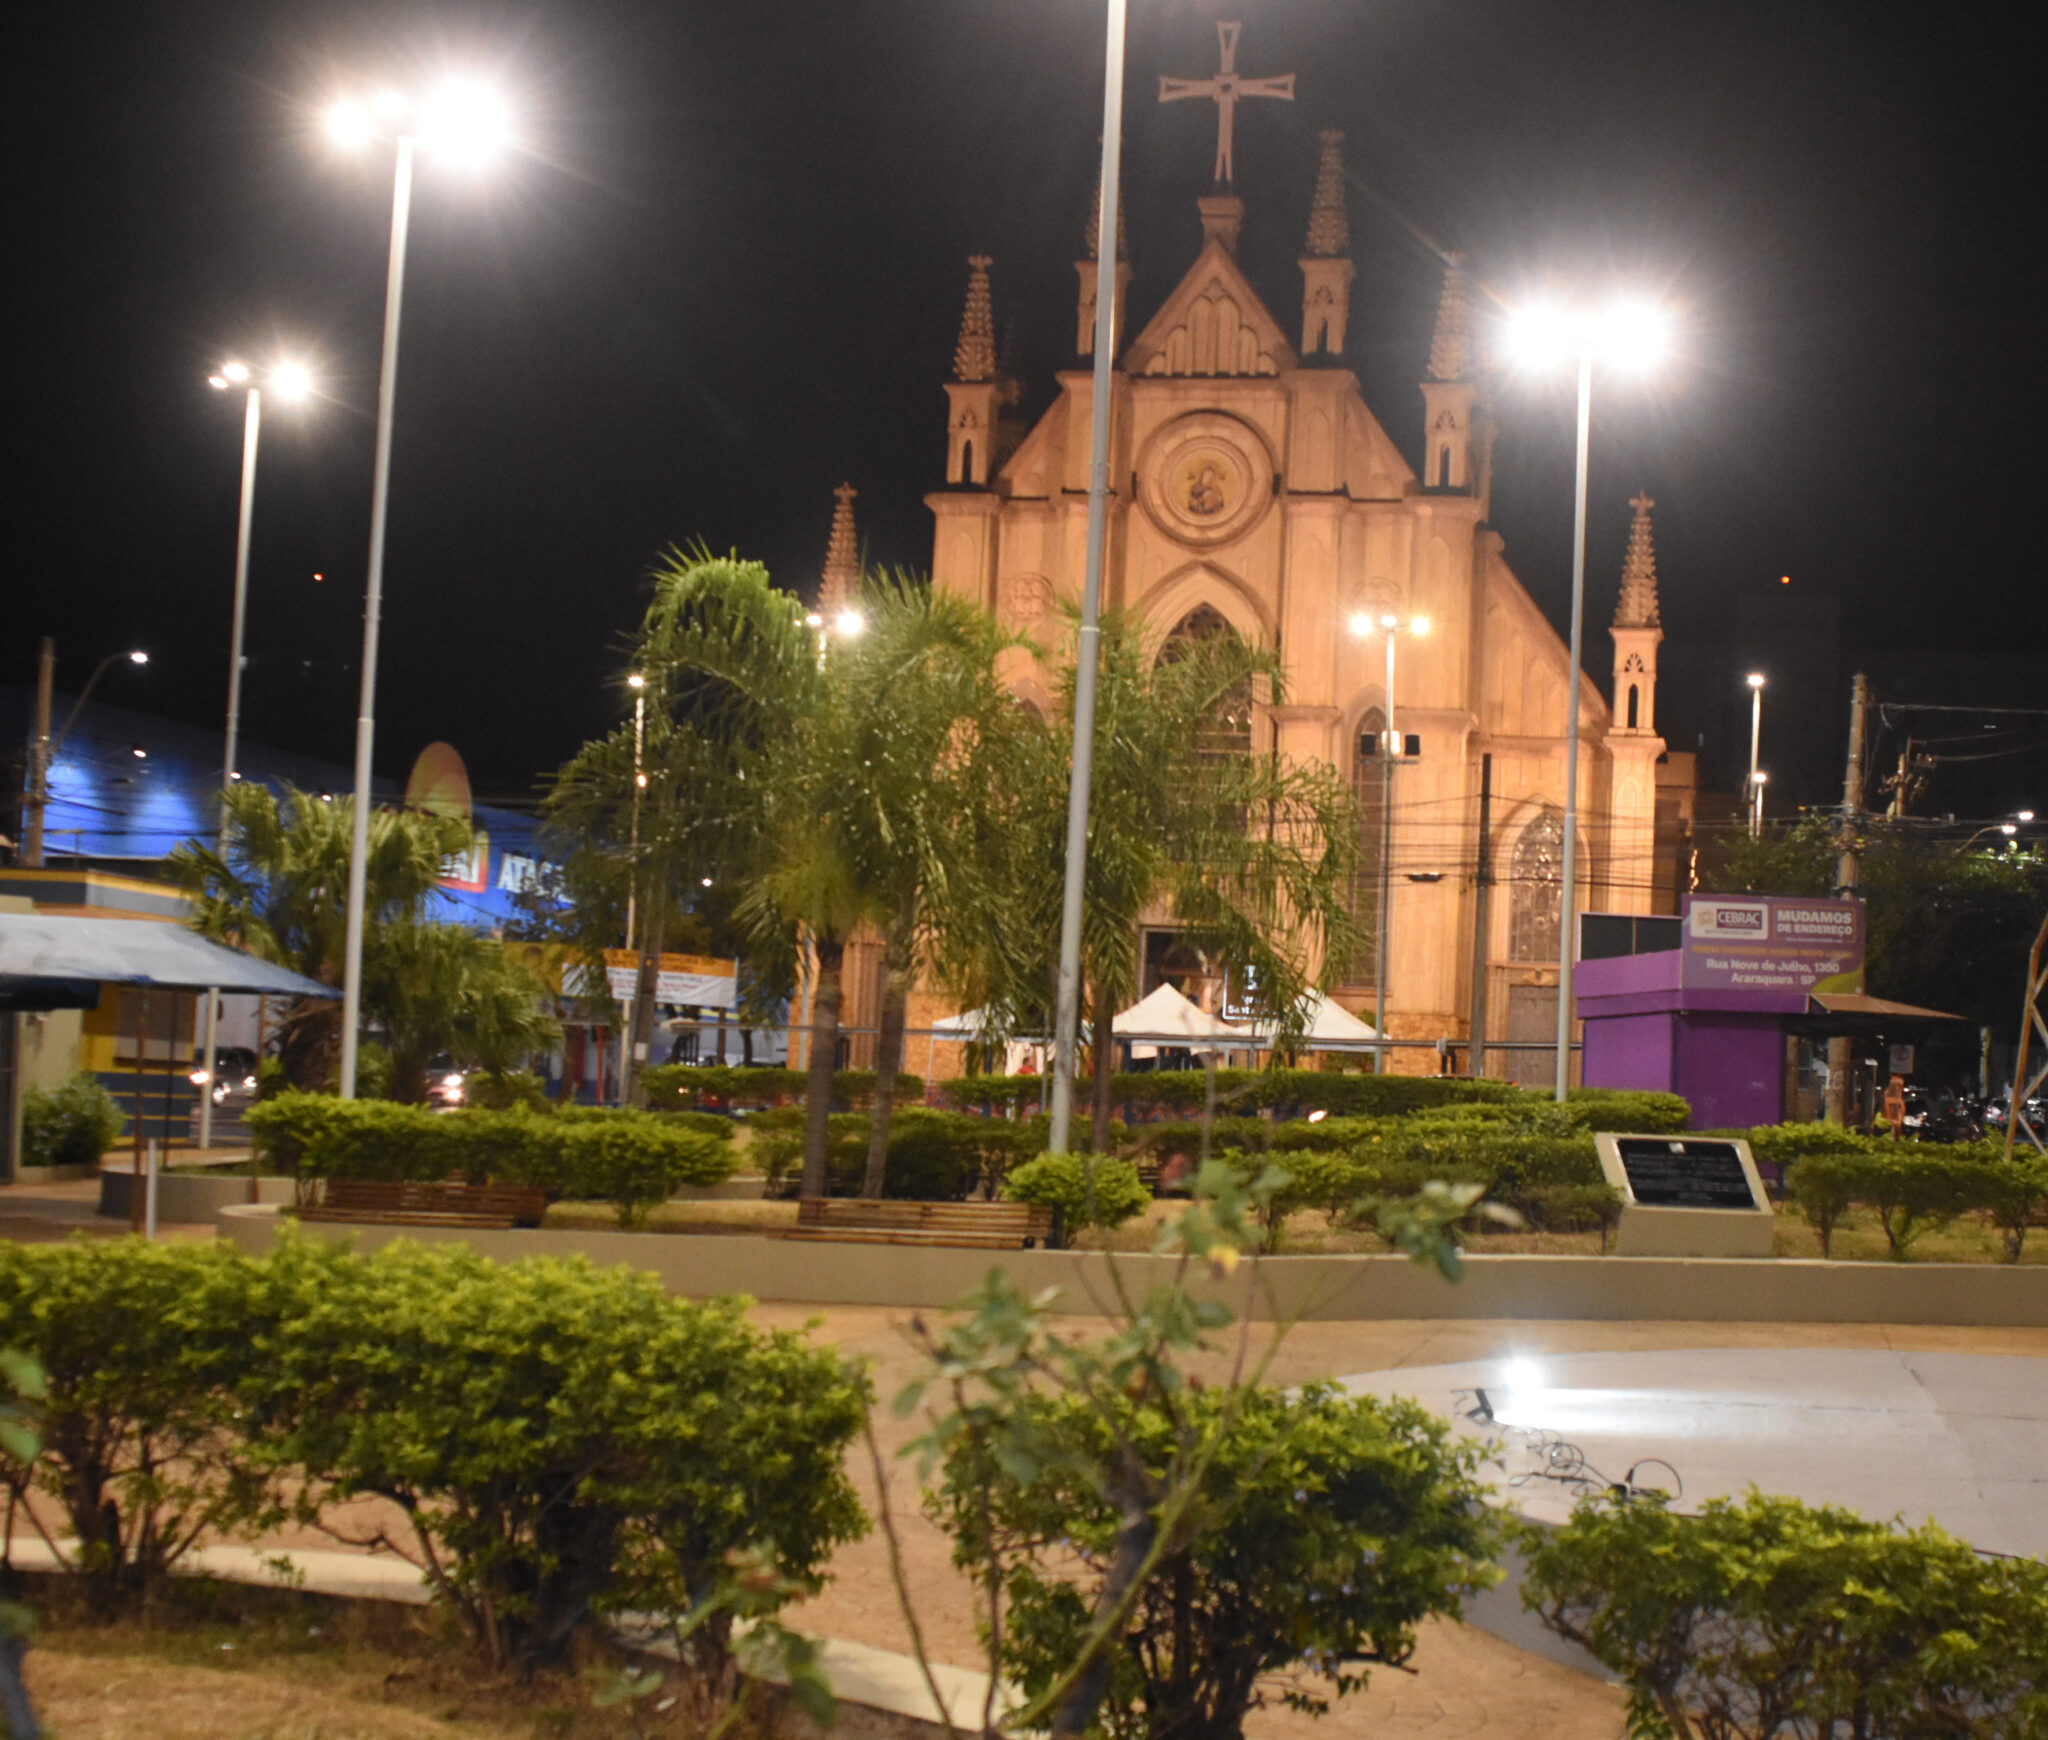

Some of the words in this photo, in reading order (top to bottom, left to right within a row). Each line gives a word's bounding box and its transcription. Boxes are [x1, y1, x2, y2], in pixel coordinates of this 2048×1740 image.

[1718, 911, 1760, 924] CEBRAC
[1777, 910, 1852, 924] MUDAMOS
[1777, 923, 1792, 933] DE
[1794, 924, 1853, 937] ENDEREÇO
[1706, 959, 1729, 969] Rua
[1731, 960, 1759, 970] Nove
[1761, 959, 1776, 971] de
[1777, 960, 1812, 973] Julho,
[1731, 972, 1793, 986] Araraquara
[1801, 975, 1816, 985] SP
